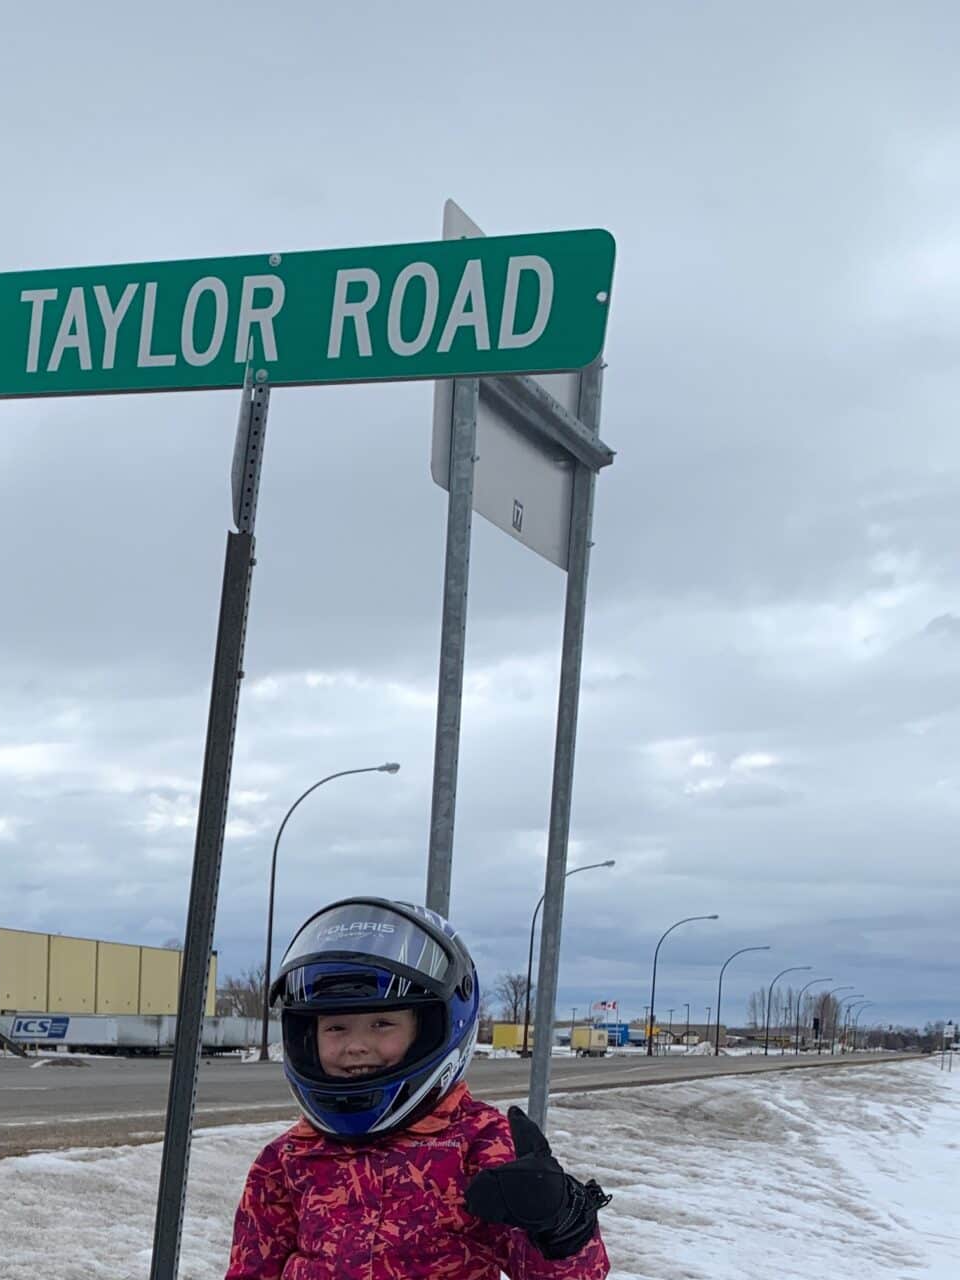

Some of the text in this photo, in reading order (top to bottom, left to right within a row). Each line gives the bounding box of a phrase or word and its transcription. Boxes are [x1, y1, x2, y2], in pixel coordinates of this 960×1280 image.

[20, 255, 554, 373] TAYLOR ROAD
[16, 1020, 50, 1033] ICS
